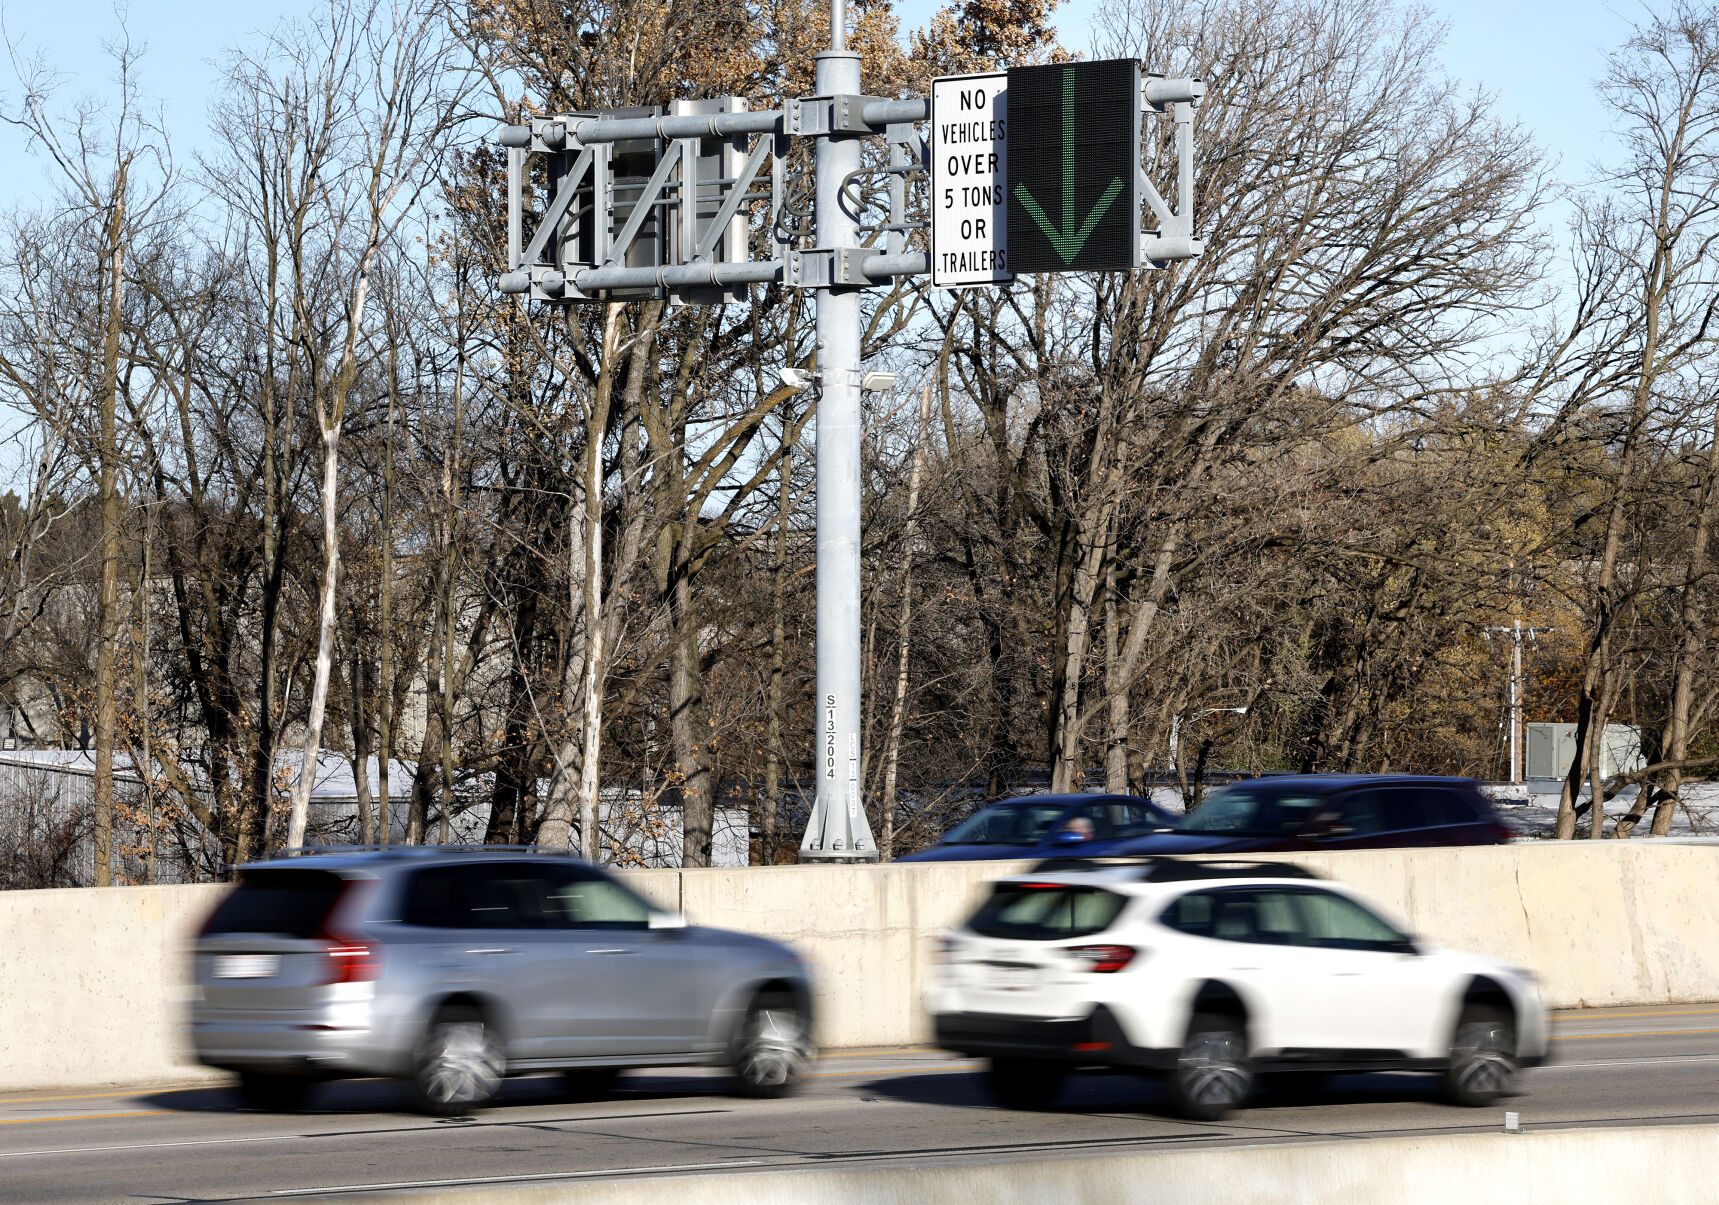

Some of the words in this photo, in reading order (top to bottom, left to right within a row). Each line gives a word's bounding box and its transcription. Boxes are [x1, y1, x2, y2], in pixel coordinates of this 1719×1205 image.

[960, 89, 986, 111] NO
[942, 119, 1005, 144] VEHICLES
[948, 153, 999, 176] OVER
[945, 188, 954, 209] 5
[962, 185, 1003, 208] TONS
[961, 219, 986, 240] OR
[942, 249, 1006, 274] TRAILERS
